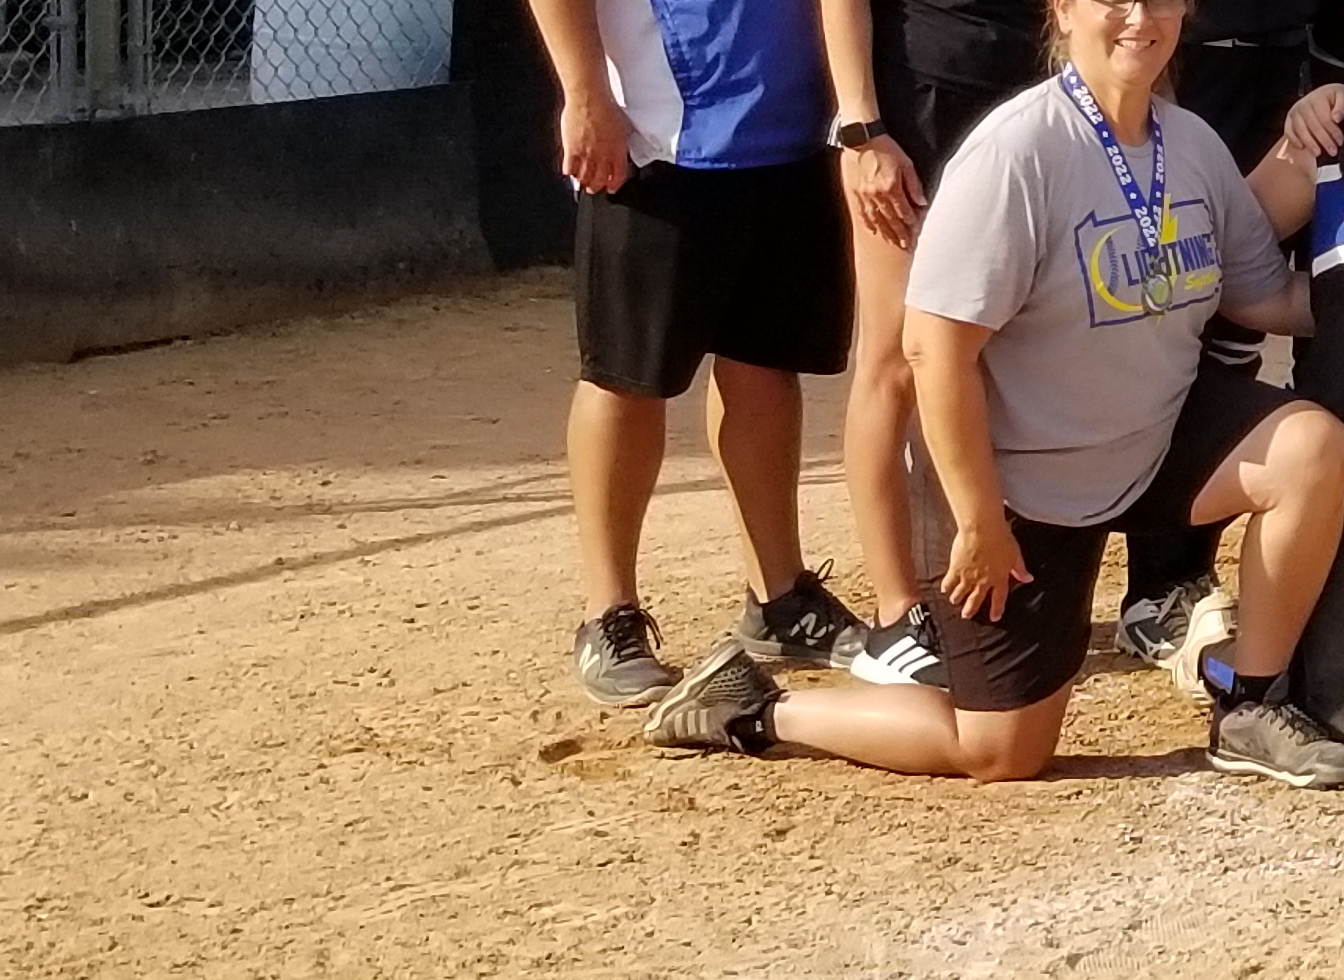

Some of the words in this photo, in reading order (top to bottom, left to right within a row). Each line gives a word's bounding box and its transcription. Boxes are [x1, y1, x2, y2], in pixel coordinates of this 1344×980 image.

[1072, 86, 1104, 124] 2022
[1106, 145, 1132, 186] 2022
[1133, 205, 1157, 247] 2022
